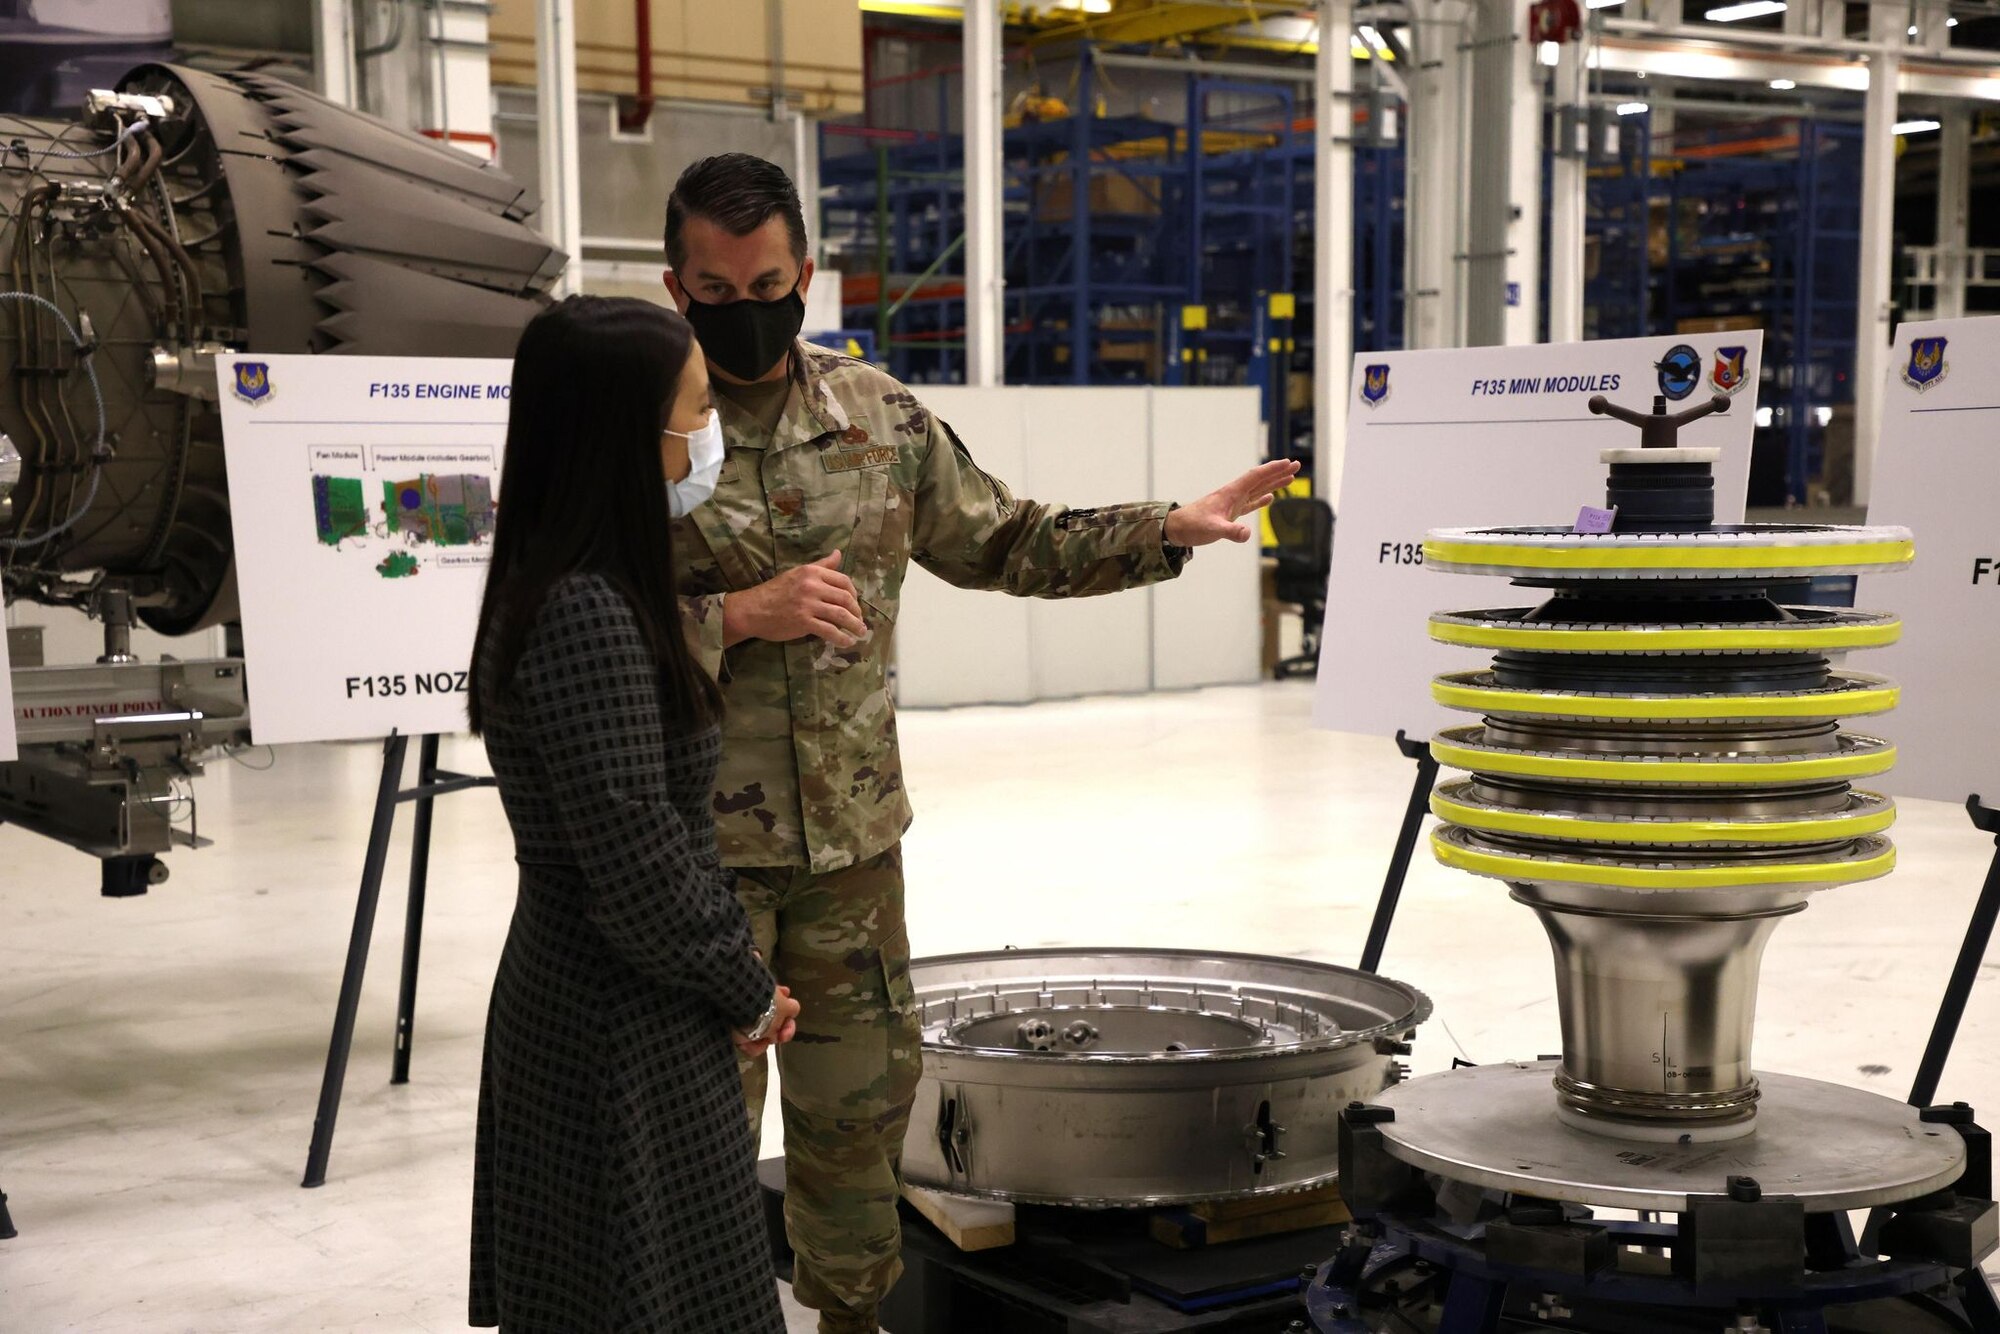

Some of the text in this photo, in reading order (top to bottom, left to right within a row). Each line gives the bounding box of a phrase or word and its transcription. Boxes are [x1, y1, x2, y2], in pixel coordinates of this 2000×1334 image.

[369, 383, 512, 399] F135 ENGINE MO
[1472, 374, 1621, 396] F135 MINI MODULES
[316, 451, 359, 460] Fan Module
[376, 454, 398, 462] Power
[399, 454, 426, 462] Module
[865, 445, 899, 464] FORCE
[1379, 542, 1424, 565] F135
[346, 671, 469, 699] F135 NOZ
[76, 703, 118, 716] PINCH
[123, 701, 162, 713] POINT
